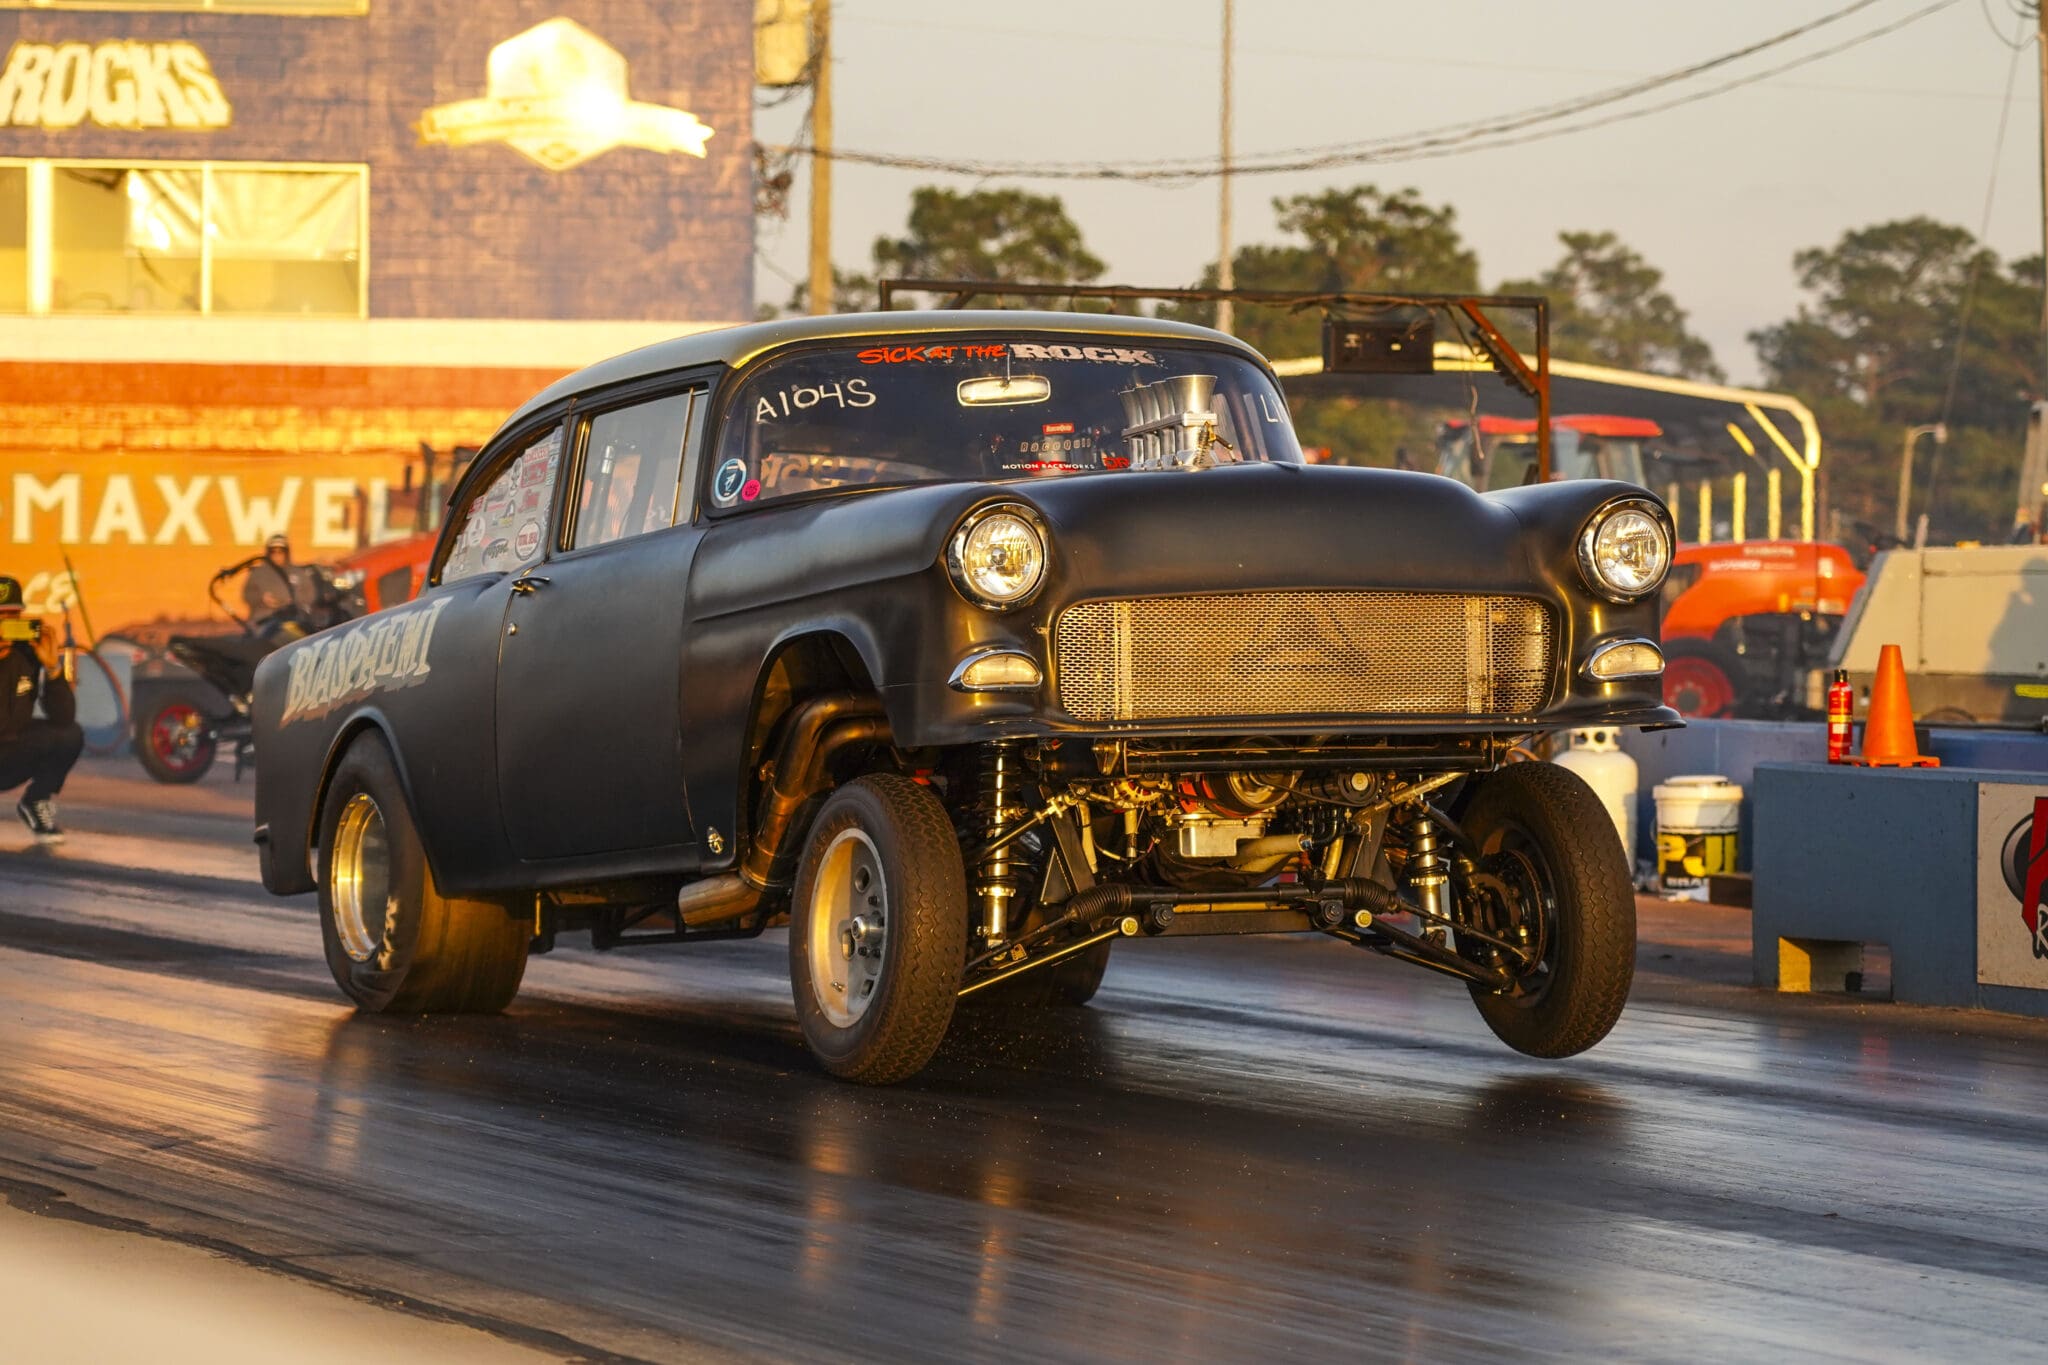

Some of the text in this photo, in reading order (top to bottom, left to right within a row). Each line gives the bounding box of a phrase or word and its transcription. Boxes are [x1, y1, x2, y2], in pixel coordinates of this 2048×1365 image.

[0, 40, 232, 128] ROCKS
[856, 343, 1157, 364] SICK AT THE ROCK
[281, 596, 454, 724] BLASPHEMI
